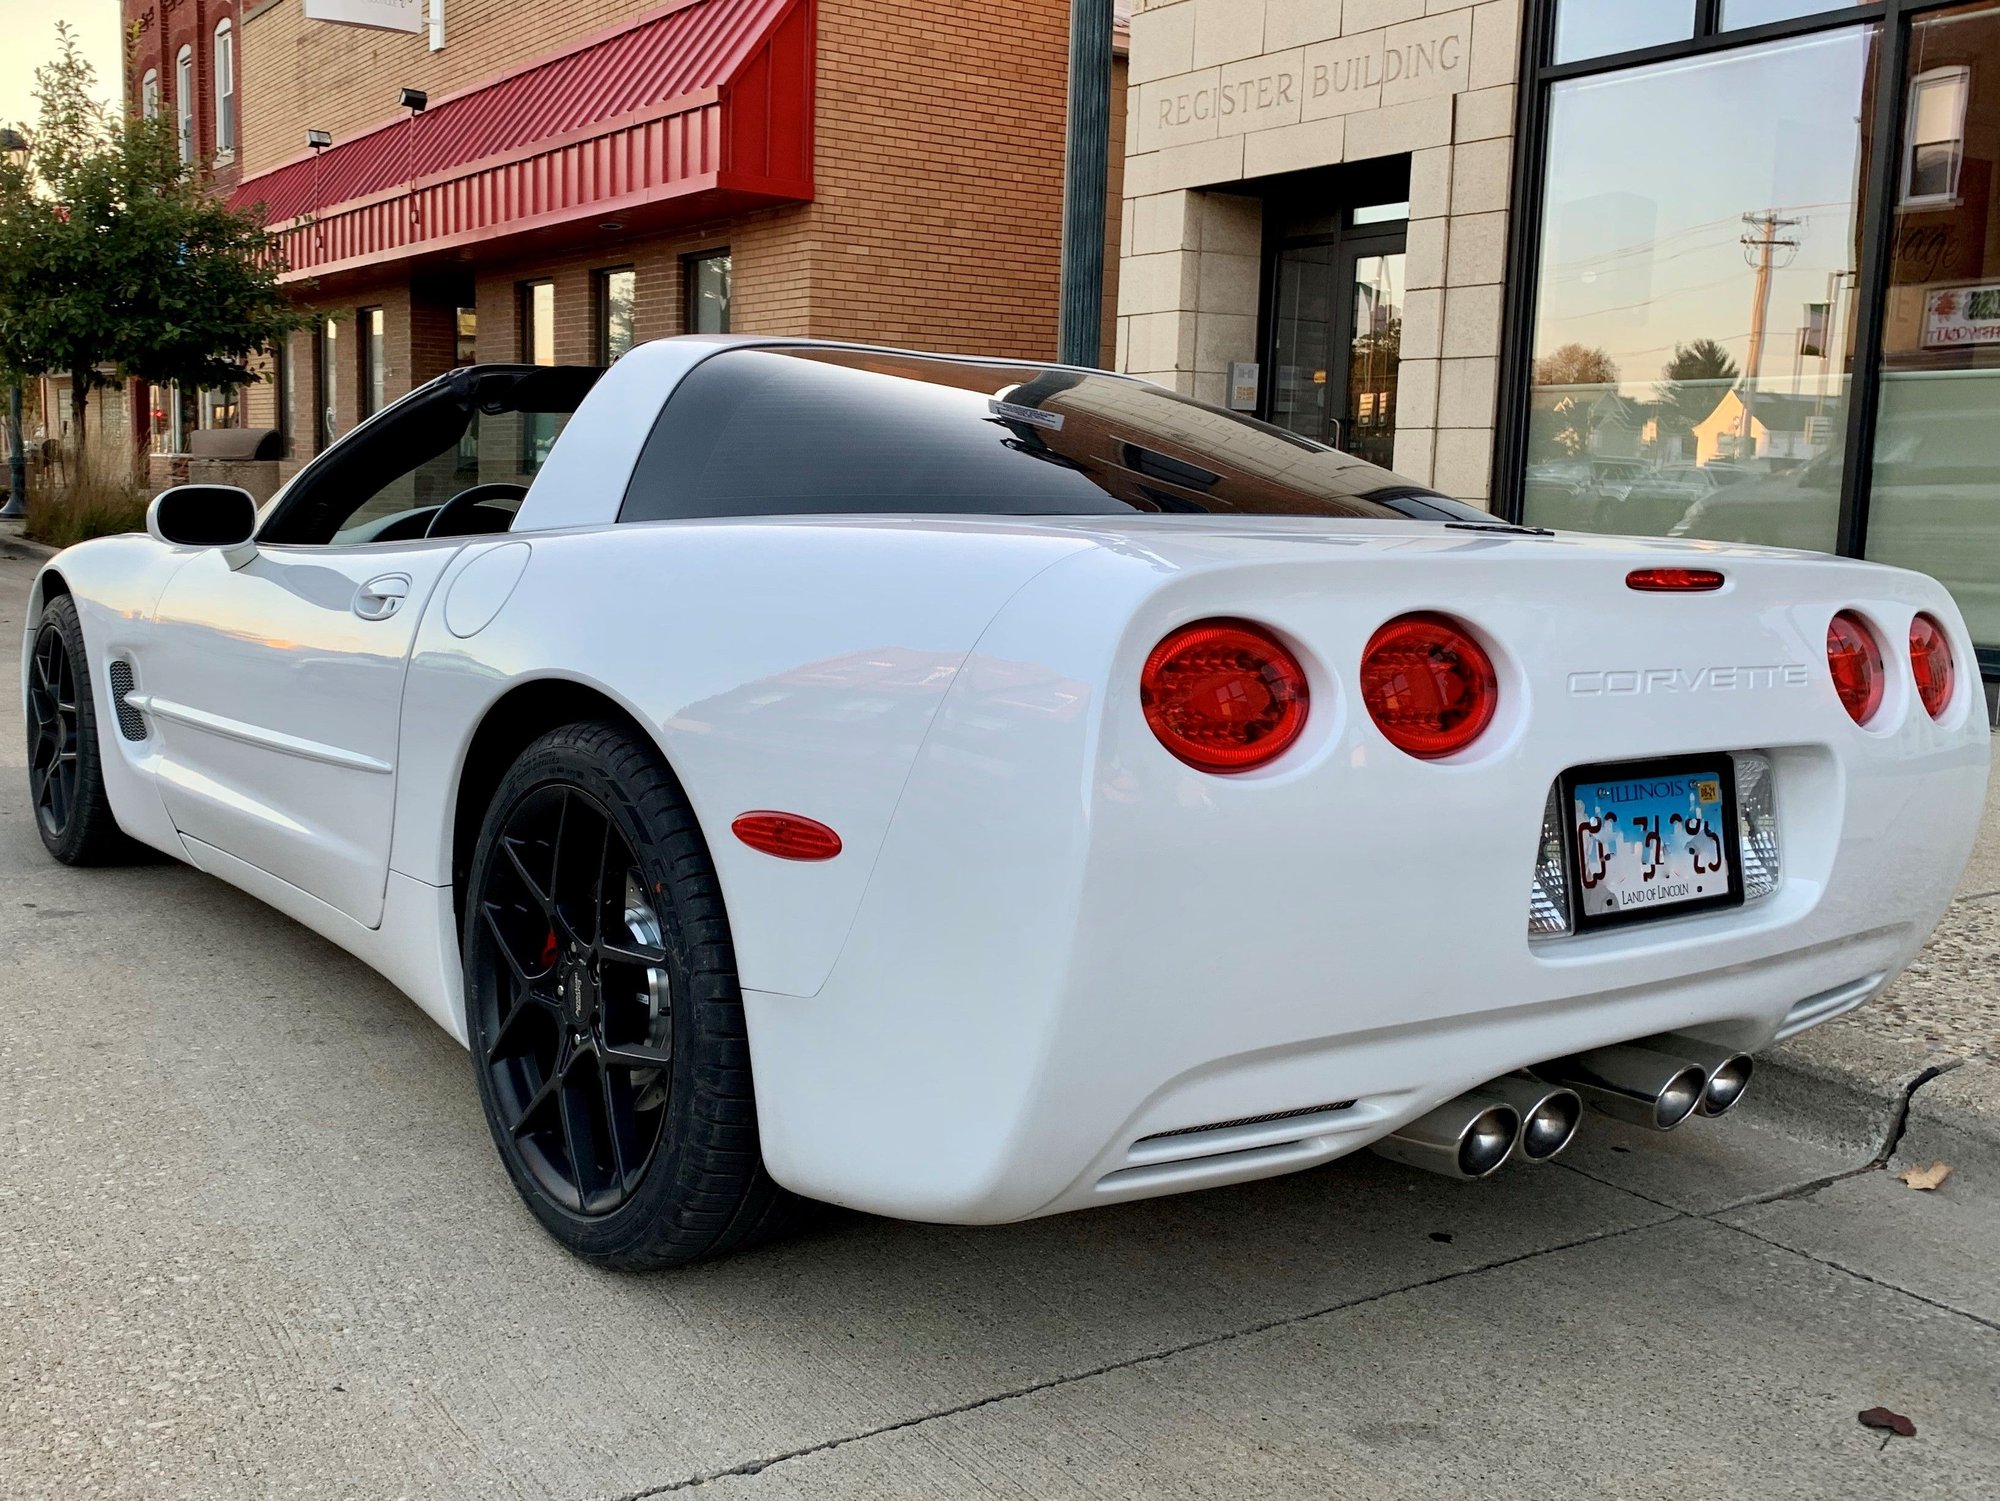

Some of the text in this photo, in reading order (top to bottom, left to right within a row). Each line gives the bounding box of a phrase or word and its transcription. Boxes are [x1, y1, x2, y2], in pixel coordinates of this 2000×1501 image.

[1158, 35, 1460, 128] REGISTER BUILDING
[1567, 664, 1808, 697] CORVETTE
[1610, 781, 1684, 803] ILLINOIS
[1622, 883, 1689, 905] LAND OF LINCOLN
